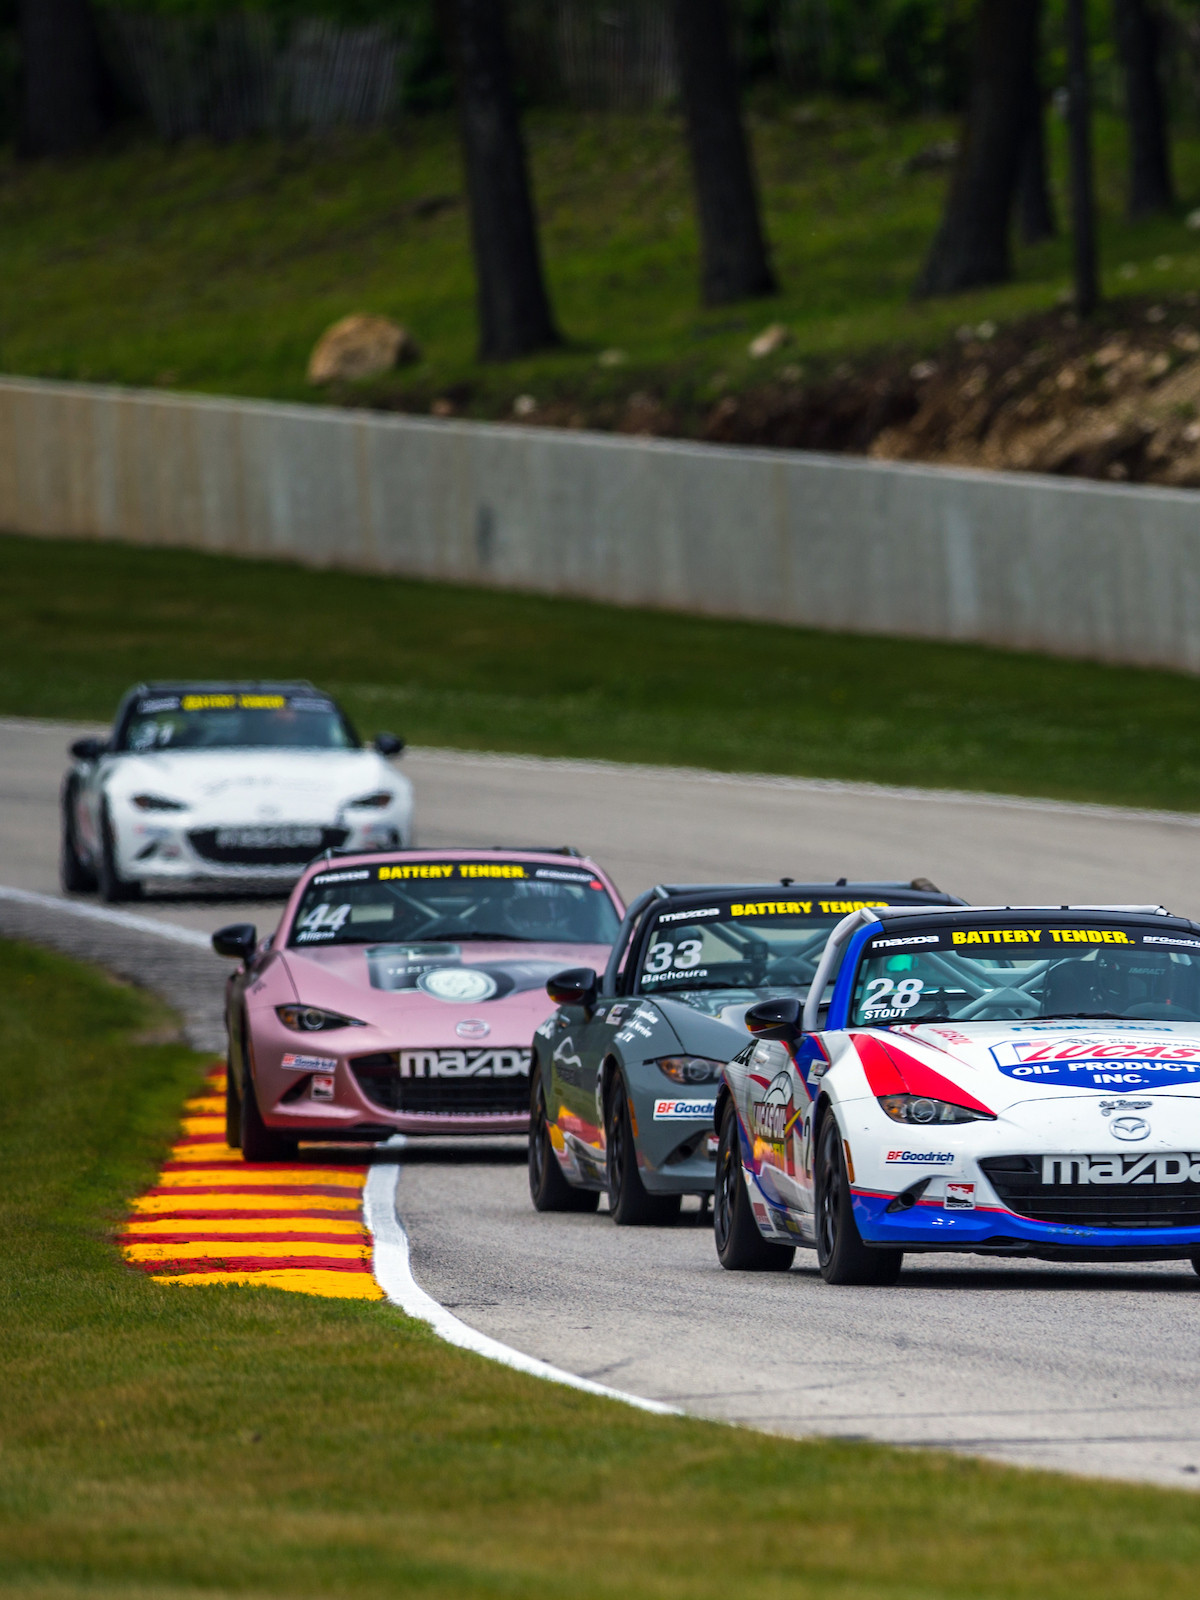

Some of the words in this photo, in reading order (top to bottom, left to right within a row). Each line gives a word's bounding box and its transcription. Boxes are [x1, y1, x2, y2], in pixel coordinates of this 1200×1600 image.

[378, 865, 454, 880] BATTERY
[659, 908, 720, 923] mazda
[730, 901, 813, 917] BATTERY
[301, 903, 351, 932] 44
[872, 935, 940, 949] mazda
[952, 930, 1042, 945] BATTERY
[646, 939, 703, 974] 33
[641, 968, 708, 985] Bachoura
[1128, 967, 1166, 976] IMPACT
[860, 978, 924, 1012] 28
[864, 1008, 909, 1020] STOUT
[1012, 1065, 1059, 1076] OIL
[1093, 1074, 1150, 1084] INC.
[656, 1102, 715, 1113] BFGoodr
[886, 1151, 955, 1162] BFGoodrich
